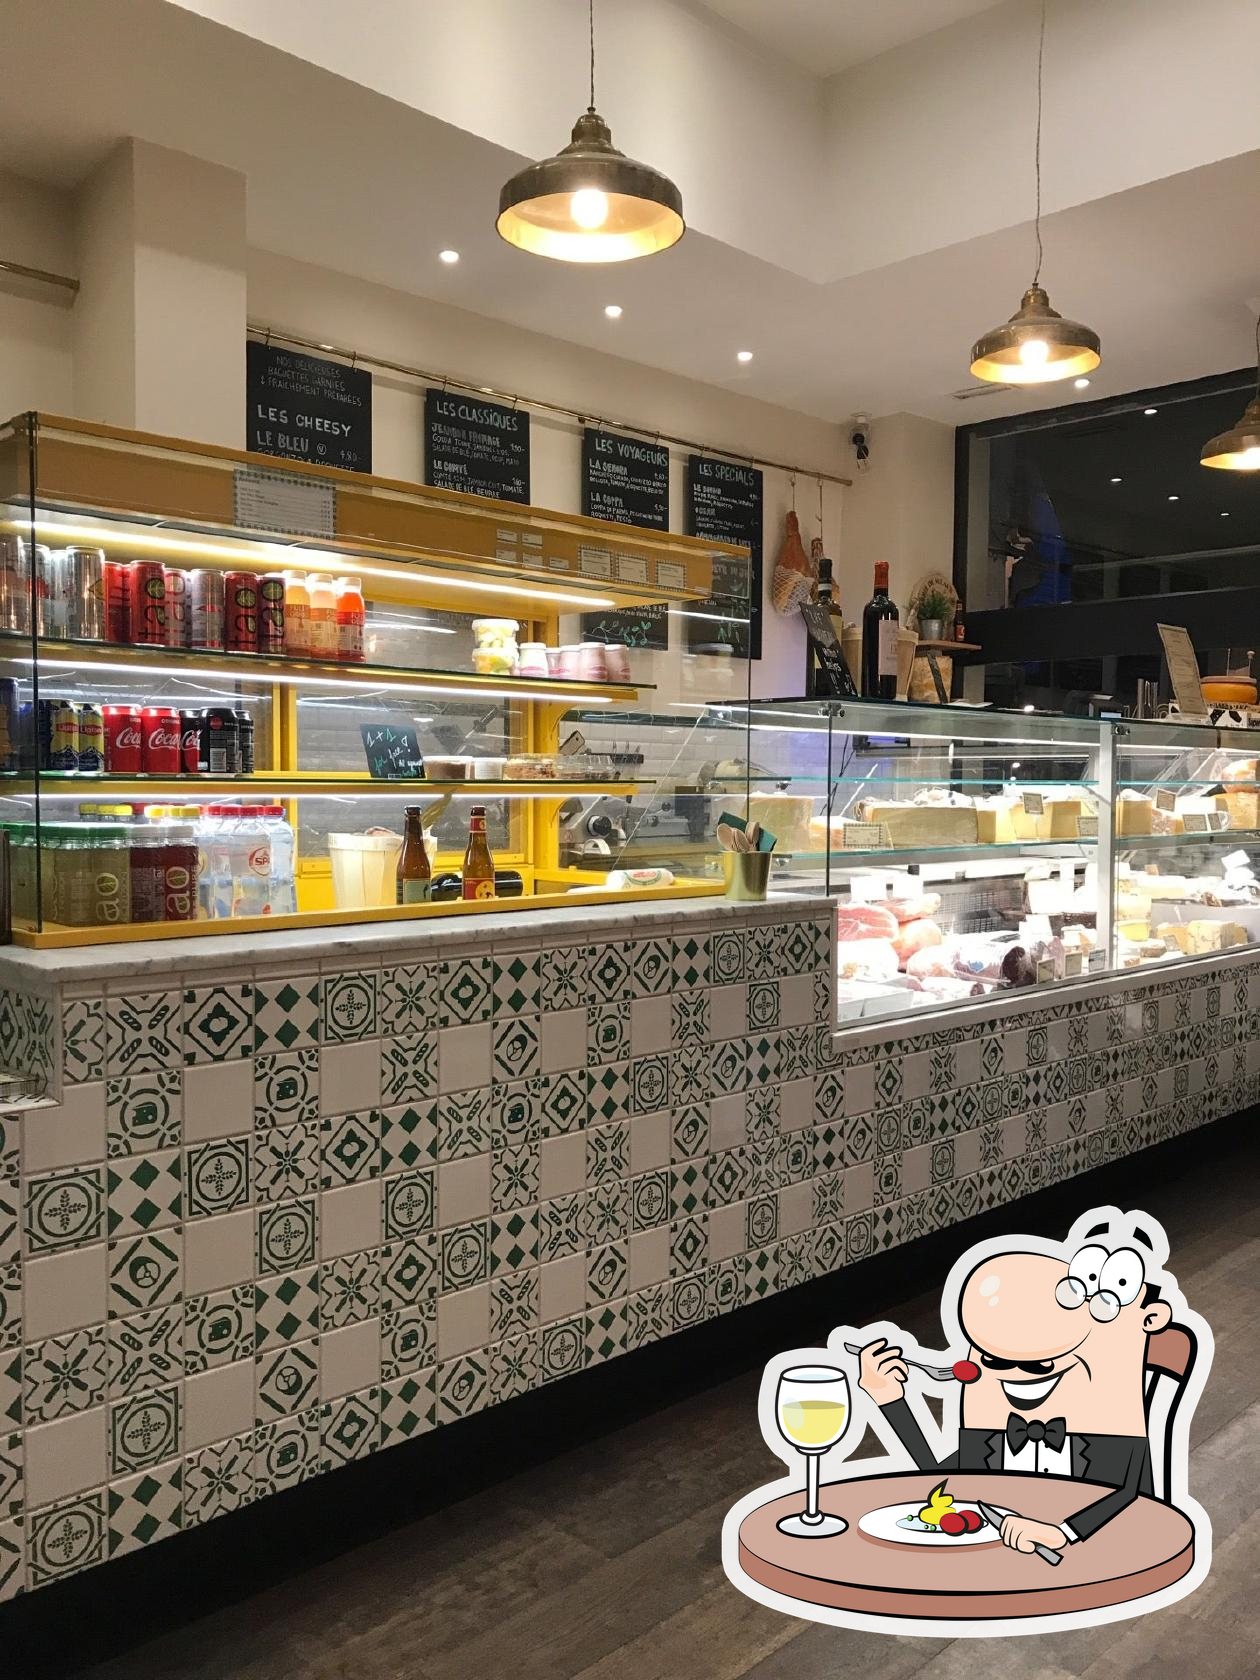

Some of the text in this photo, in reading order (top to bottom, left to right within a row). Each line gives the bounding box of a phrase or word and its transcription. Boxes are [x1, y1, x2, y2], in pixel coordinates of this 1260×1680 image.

[437, 400, 456, 417] LES
[257, 404, 352, 437] LES CHEESY
[257, 430, 273, 446] LE
[278, 432, 309, 453] BLEU
[595, 438, 668, 467] LES VOYAGEURS
[433, 460, 443, 470] LE
[589, 458, 601, 470] LA
[699, 464, 713, 477] LES
[591, 491, 601, 502] LA
[96, 872, 120, 922] ao
[165, 866, 190, 918] ao
